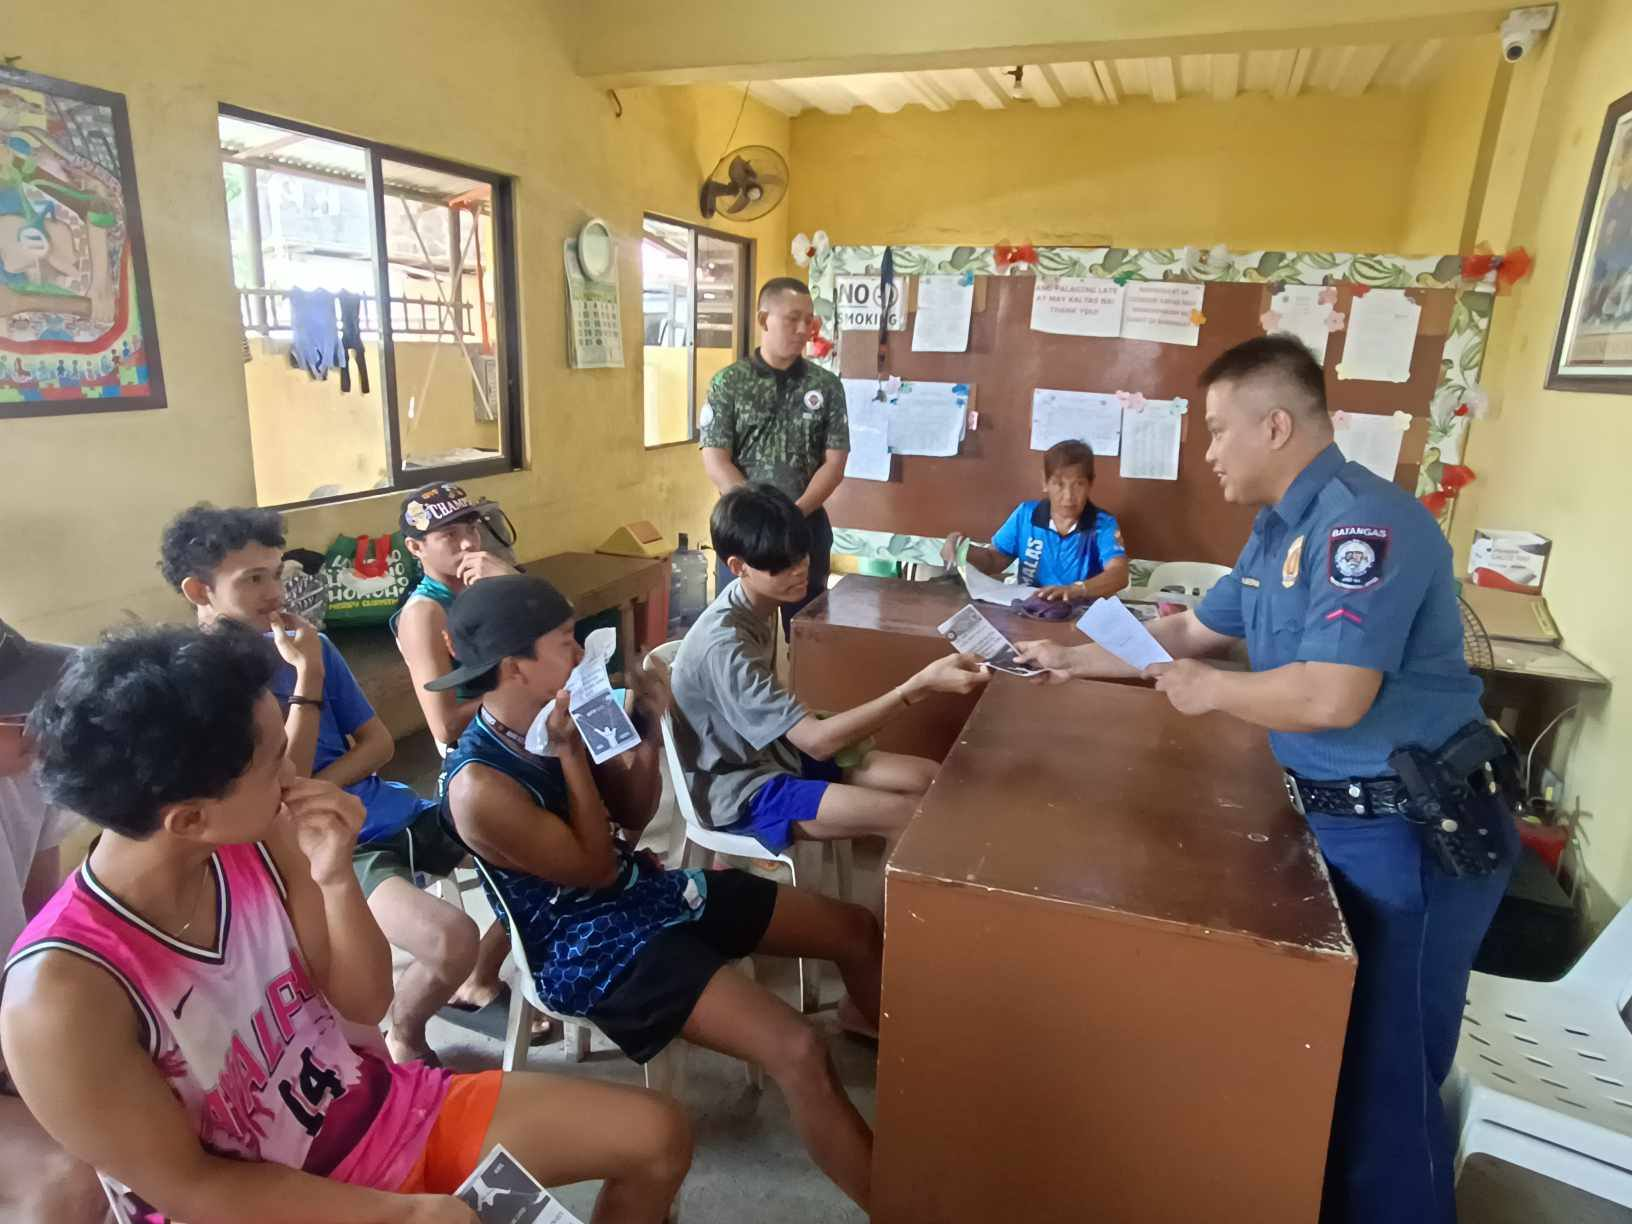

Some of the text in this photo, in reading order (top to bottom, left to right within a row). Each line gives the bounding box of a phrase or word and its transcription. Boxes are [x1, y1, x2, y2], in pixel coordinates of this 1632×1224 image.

[838, 283, 869, 304] NO
[838, 312, 897, 326] SMOKIG
[1331, 527, 1387, 538] BATANGAS
[278, 1046, 346, 1137] 14
